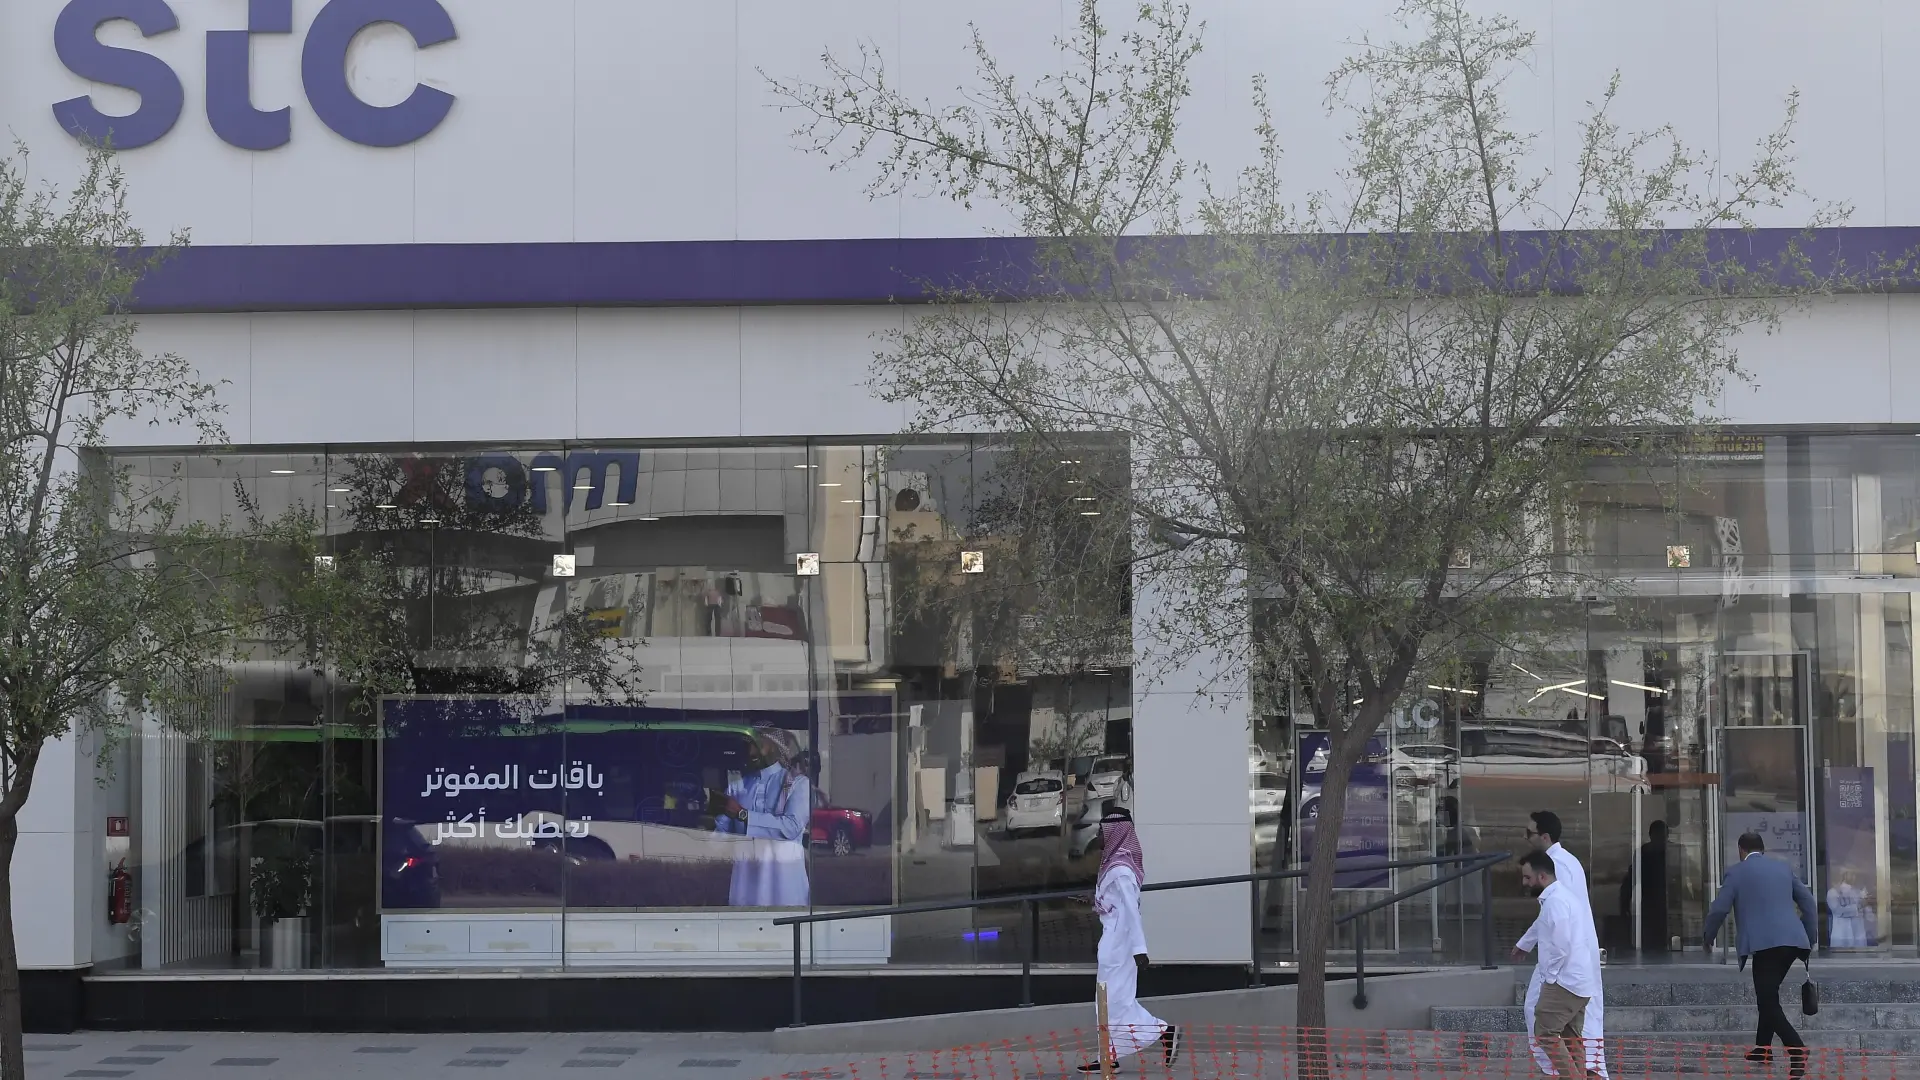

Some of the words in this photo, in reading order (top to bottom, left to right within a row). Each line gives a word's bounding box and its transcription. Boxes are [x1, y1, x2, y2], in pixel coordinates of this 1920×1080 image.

[52, 0, 458, 150] stc
[420, 764, 519, 797] المفوتر
[528, 760, 604, 796] باقات
[431, 806, 486, 846] أكثر
[494, 812, 592, 846] تعطيك
